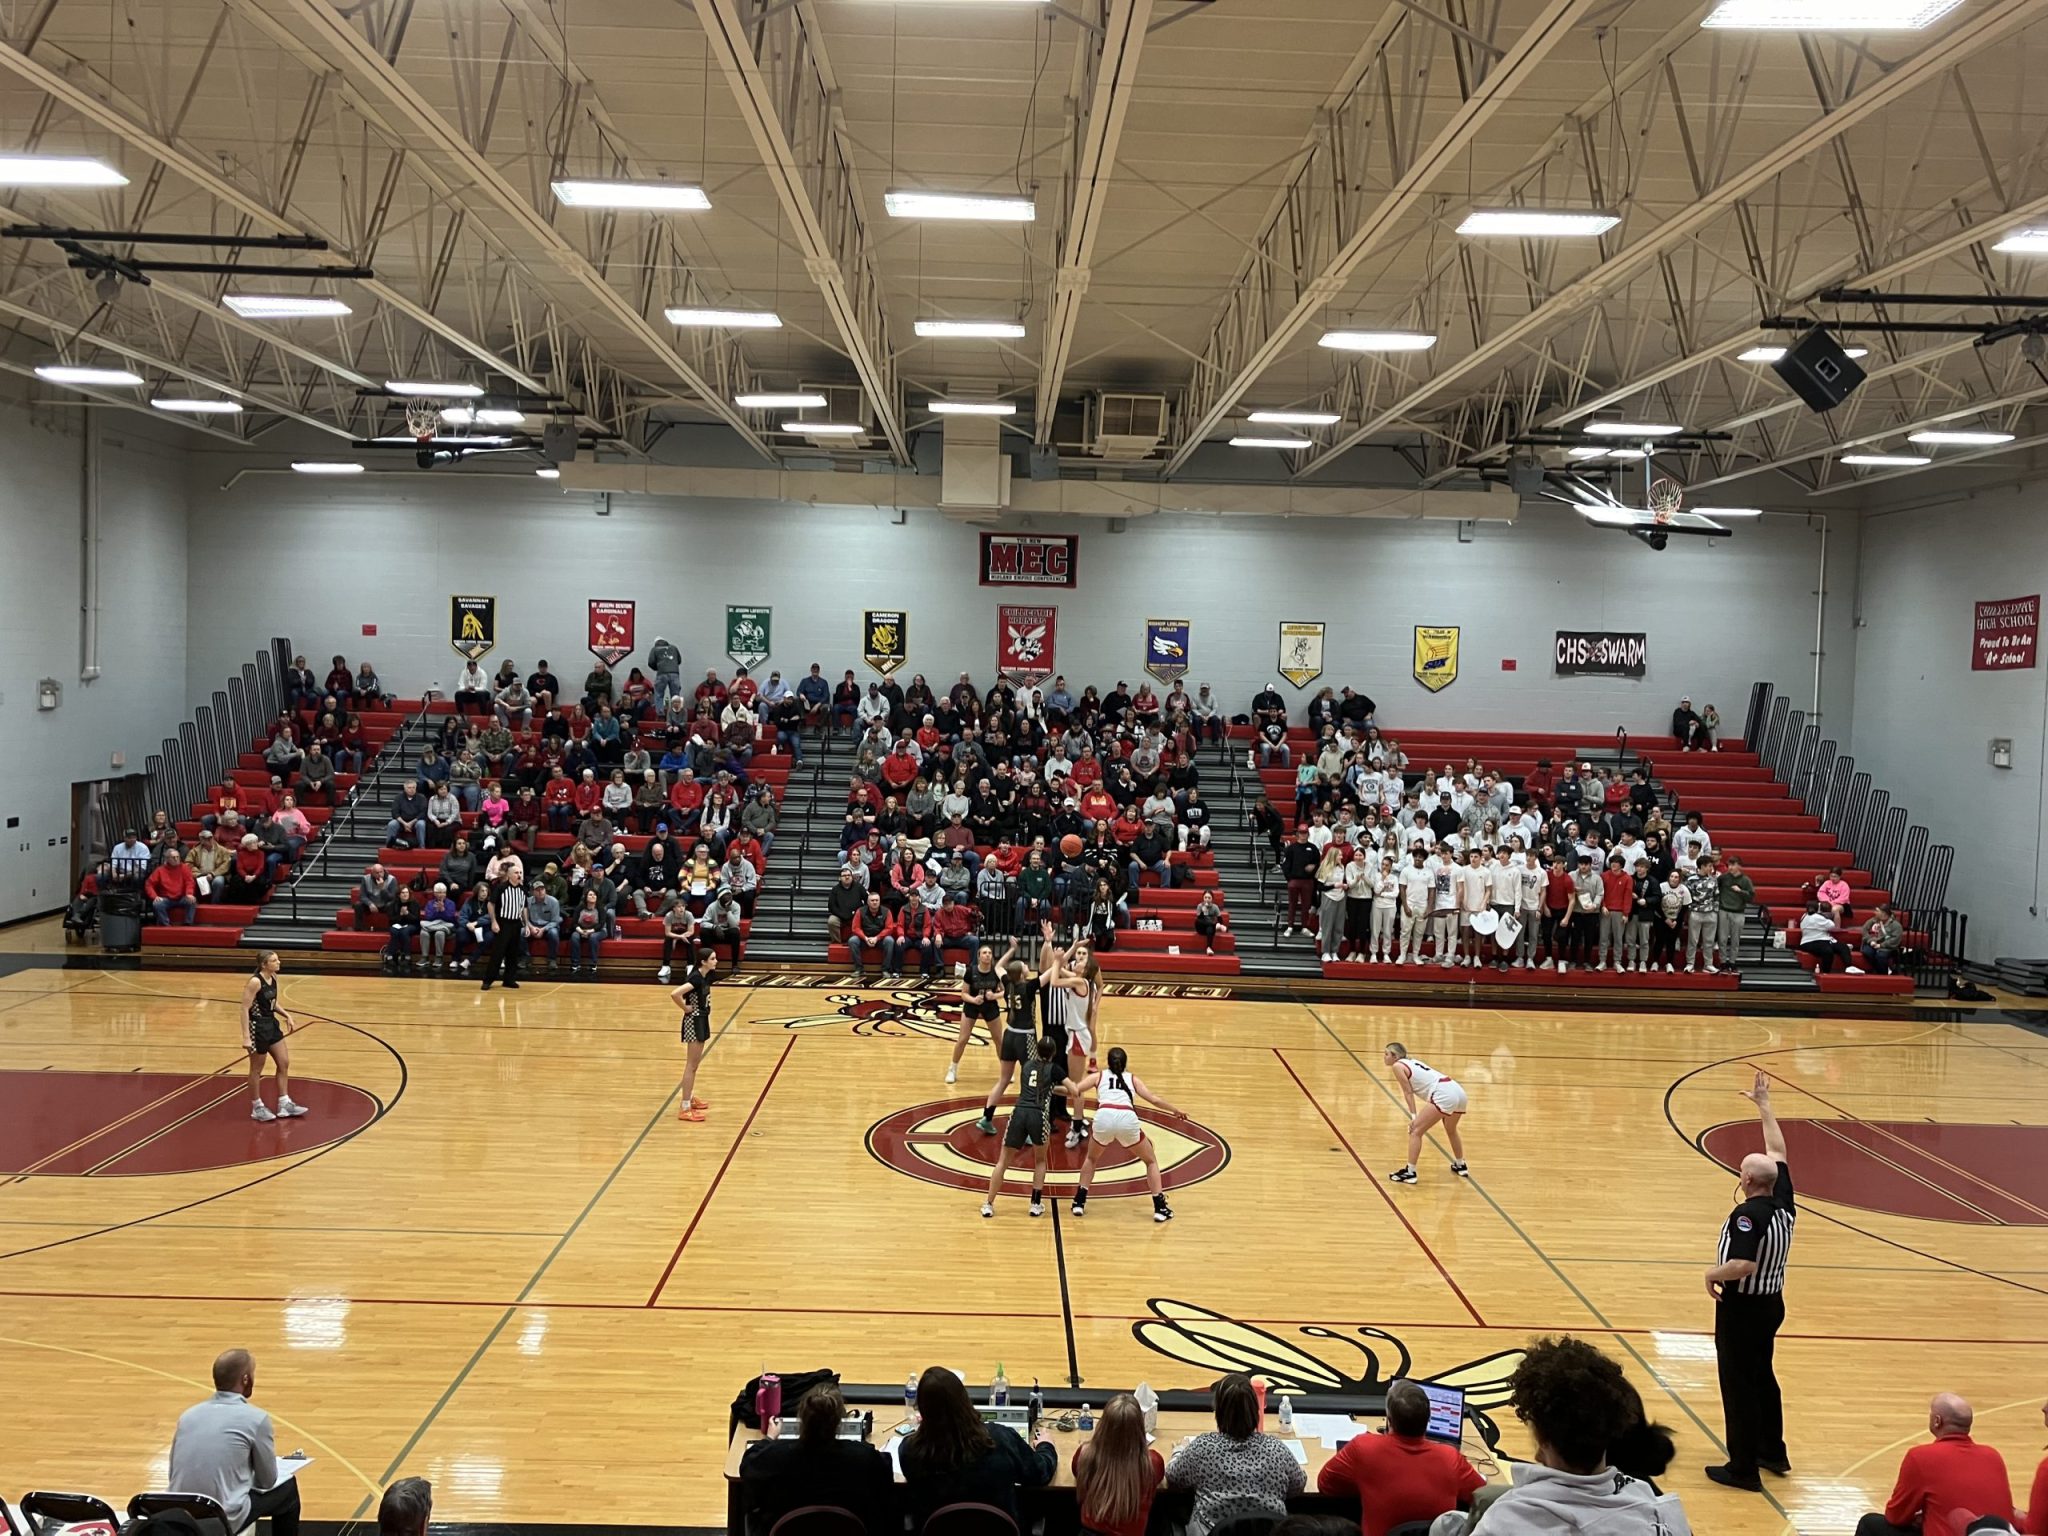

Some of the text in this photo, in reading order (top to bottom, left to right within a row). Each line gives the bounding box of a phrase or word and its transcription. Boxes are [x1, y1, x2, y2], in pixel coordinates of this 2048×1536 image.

[989, 543, 1068, 576] MEC
[1977, 614, 2037, 630] HIGH SCHOOL
[1980, 636, 2001, 648] Proud
[2002, 635, 2010, 647] To
[1556, 637, 1646, 668] CHS SWARM
[2000, 651, 2026, 665] School
[1028, 1069, 1038, 1087] 2
